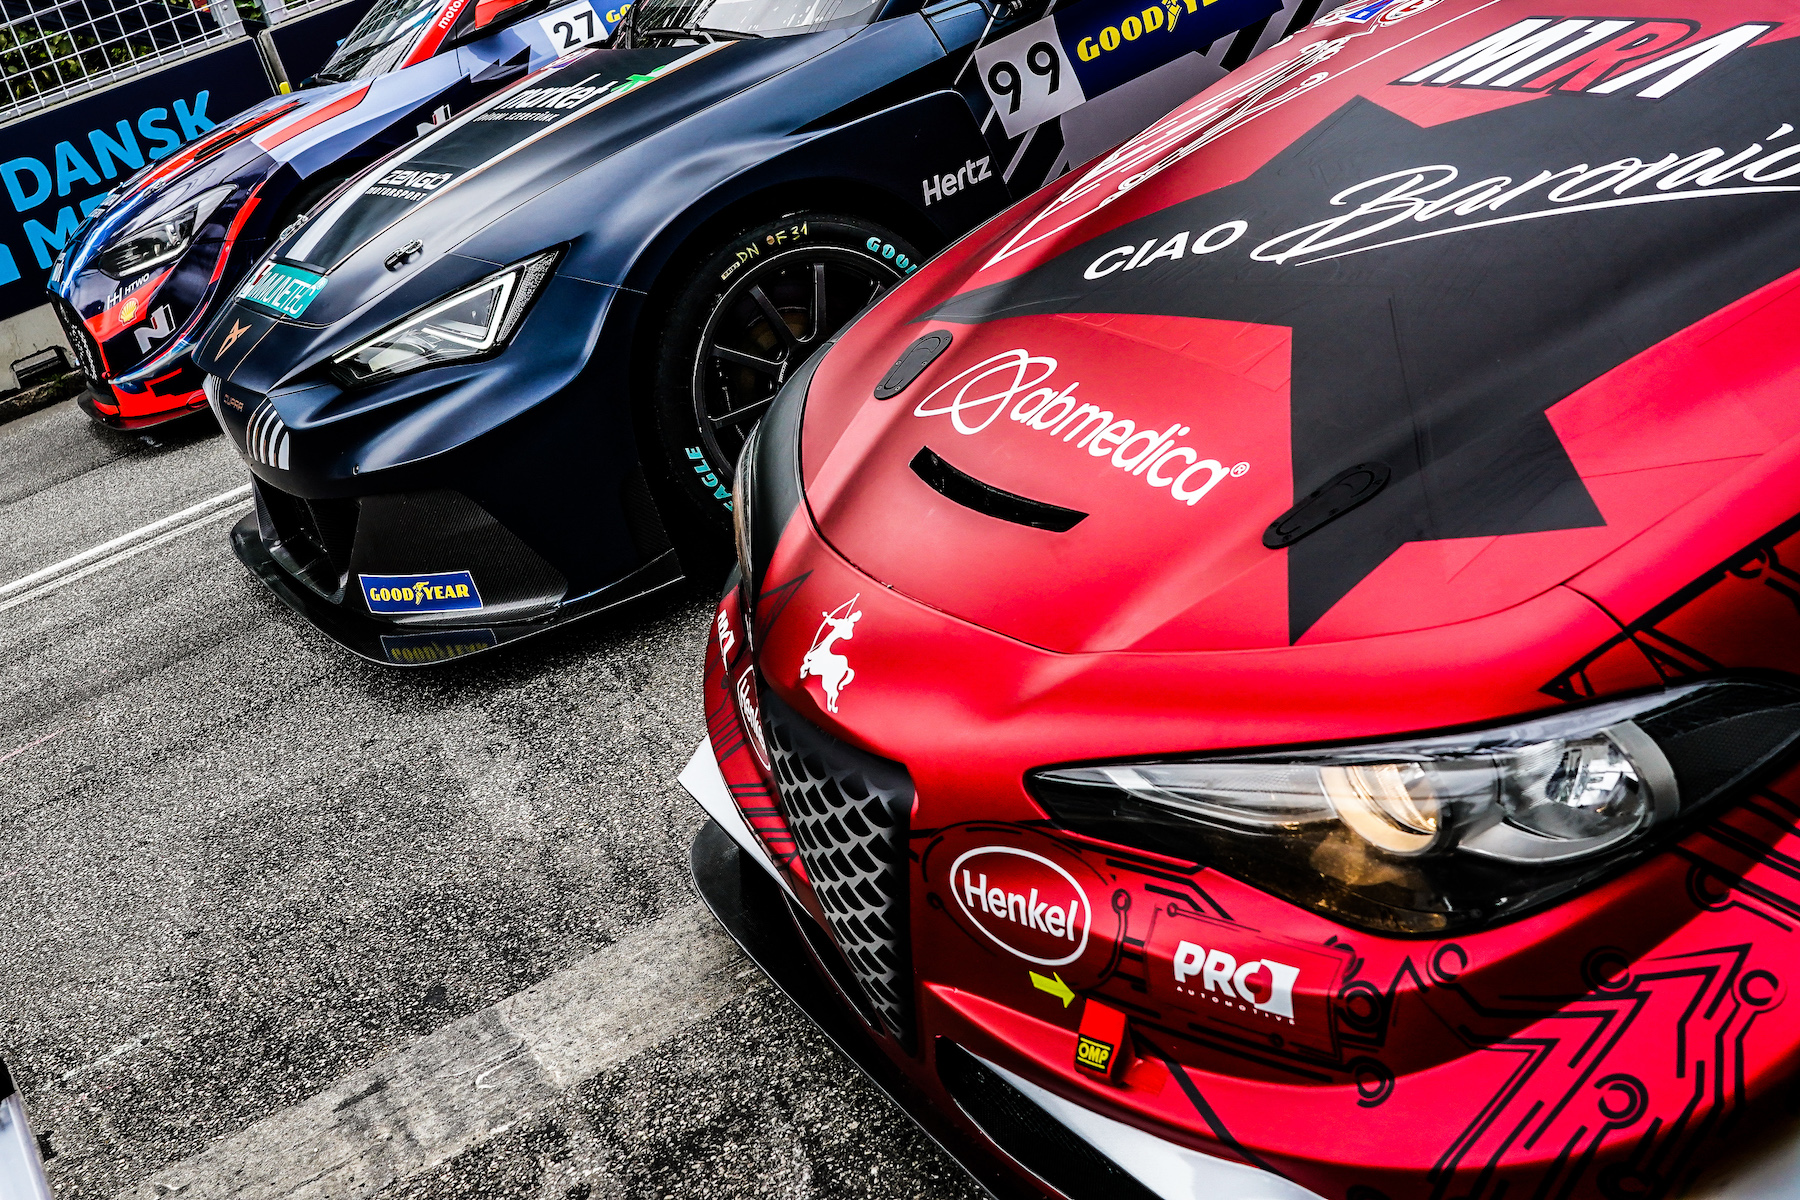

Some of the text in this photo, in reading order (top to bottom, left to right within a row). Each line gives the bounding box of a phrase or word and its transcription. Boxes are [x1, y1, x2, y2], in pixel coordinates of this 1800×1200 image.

[552, 9, 595, 49] 27
[494, 73, 619, 111] market
[986, 41, 1061, 116] 99
[0, 89, 220, 213] DANSK
[364, 186, 428, 202] MOTORSPORT
[922, 155, 994, 207] Hertz
[1083, 219, 1249, 281] CIAO
[124, 272, 150, 297] HTWO
[962, 869, 1079, 942] Henkel
[1173, 939, 1301, 1019] PRO
[1176, 985, 1296, 1026] AUTOMOTIVE
[1077, 1044, 1110, 1066] OMP
